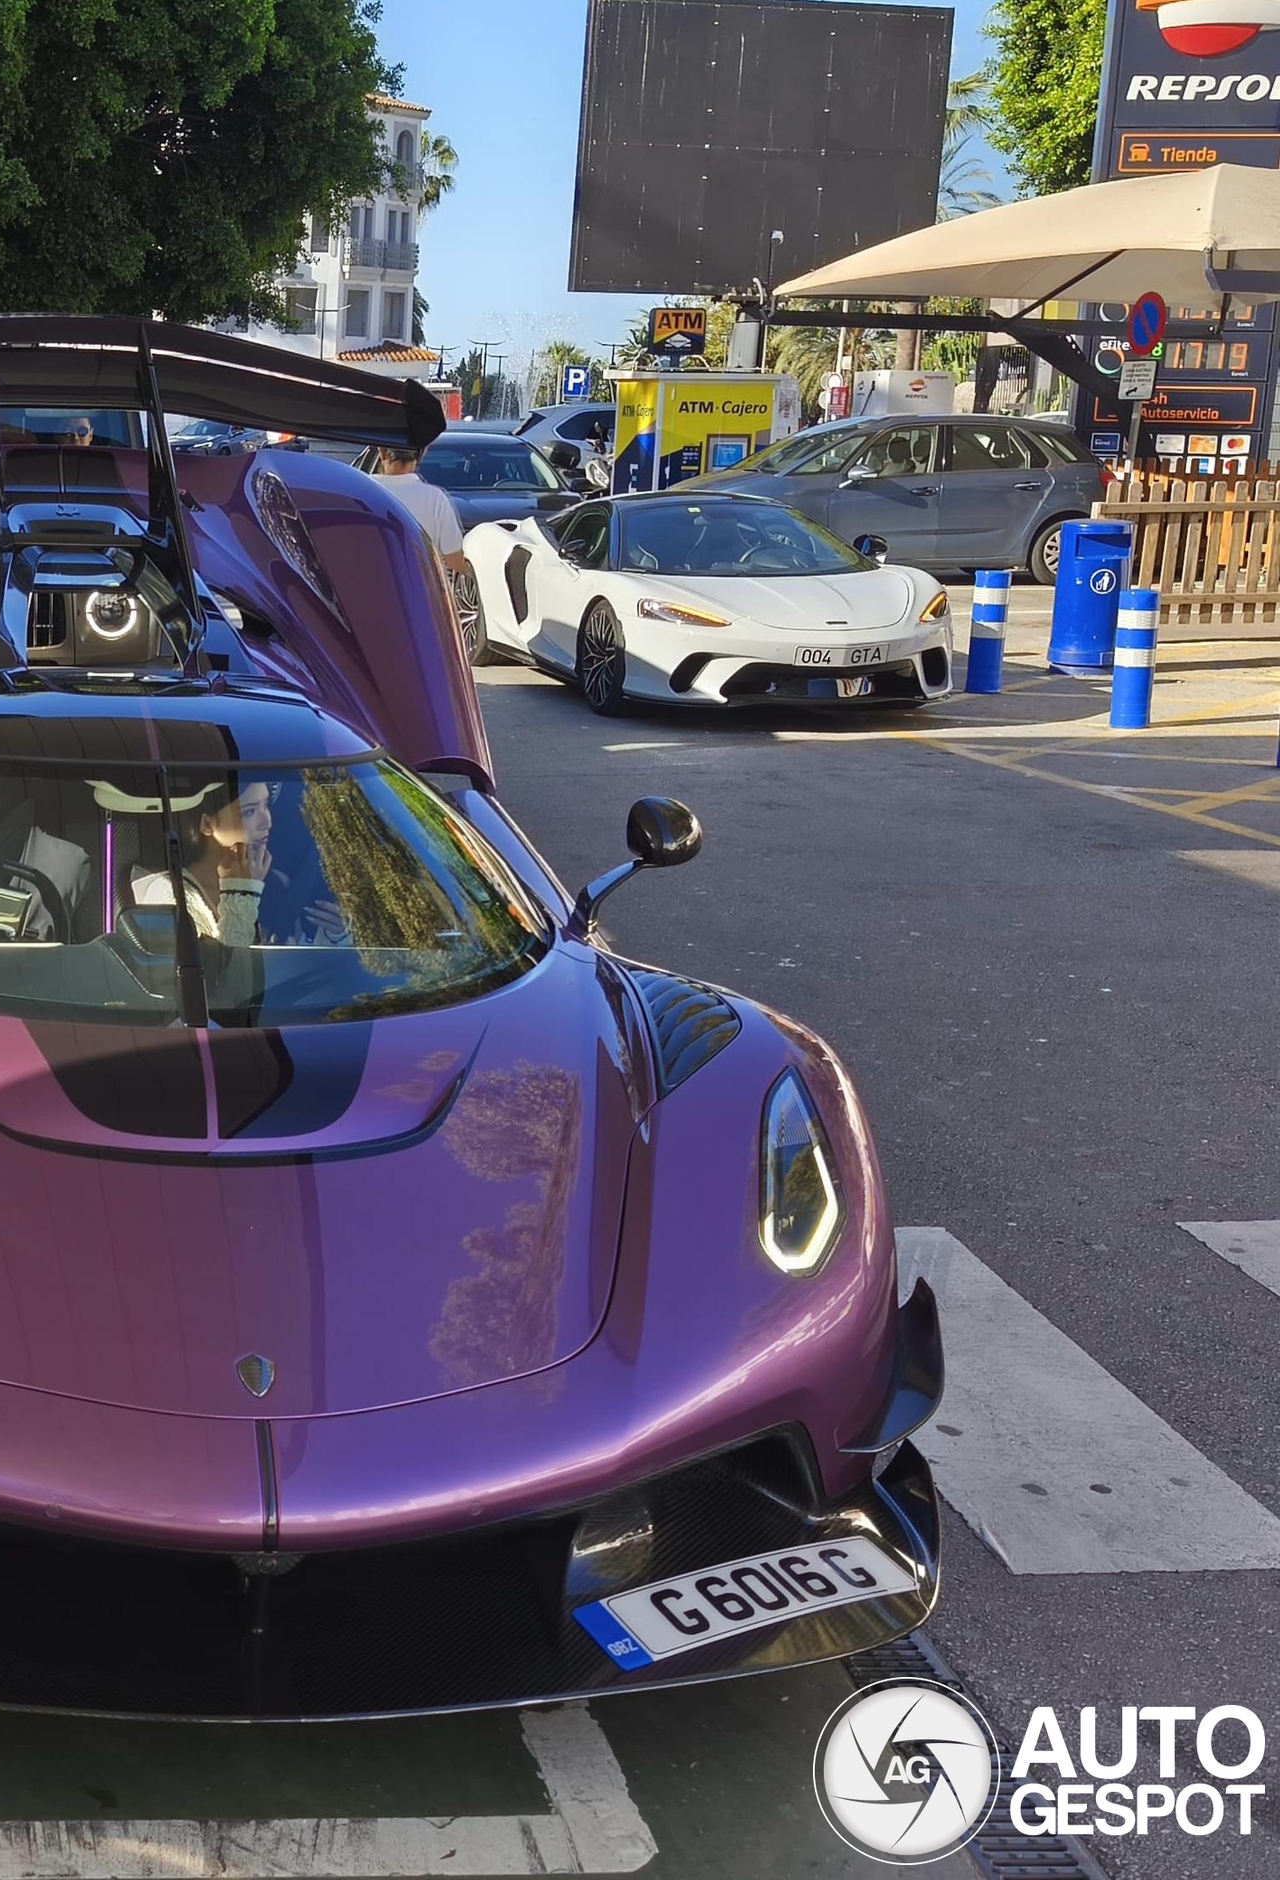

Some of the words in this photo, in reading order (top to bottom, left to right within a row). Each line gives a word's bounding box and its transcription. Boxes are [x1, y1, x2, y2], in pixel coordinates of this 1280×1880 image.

[1161, 147, 1217, 162] Tienda
[657, 312, 703, 329] ATM
[568, 369, 585, 391] P
[678, 401, 714, 414] ATM
[721, 400, 768, 417] Cajero
[1141, 407, 1219, 420] Autoservicio
[801, 649, 831, 664] 004
[851, 647, 882, 664] GTA
[607, 1638, 639, 1657] GBZ
